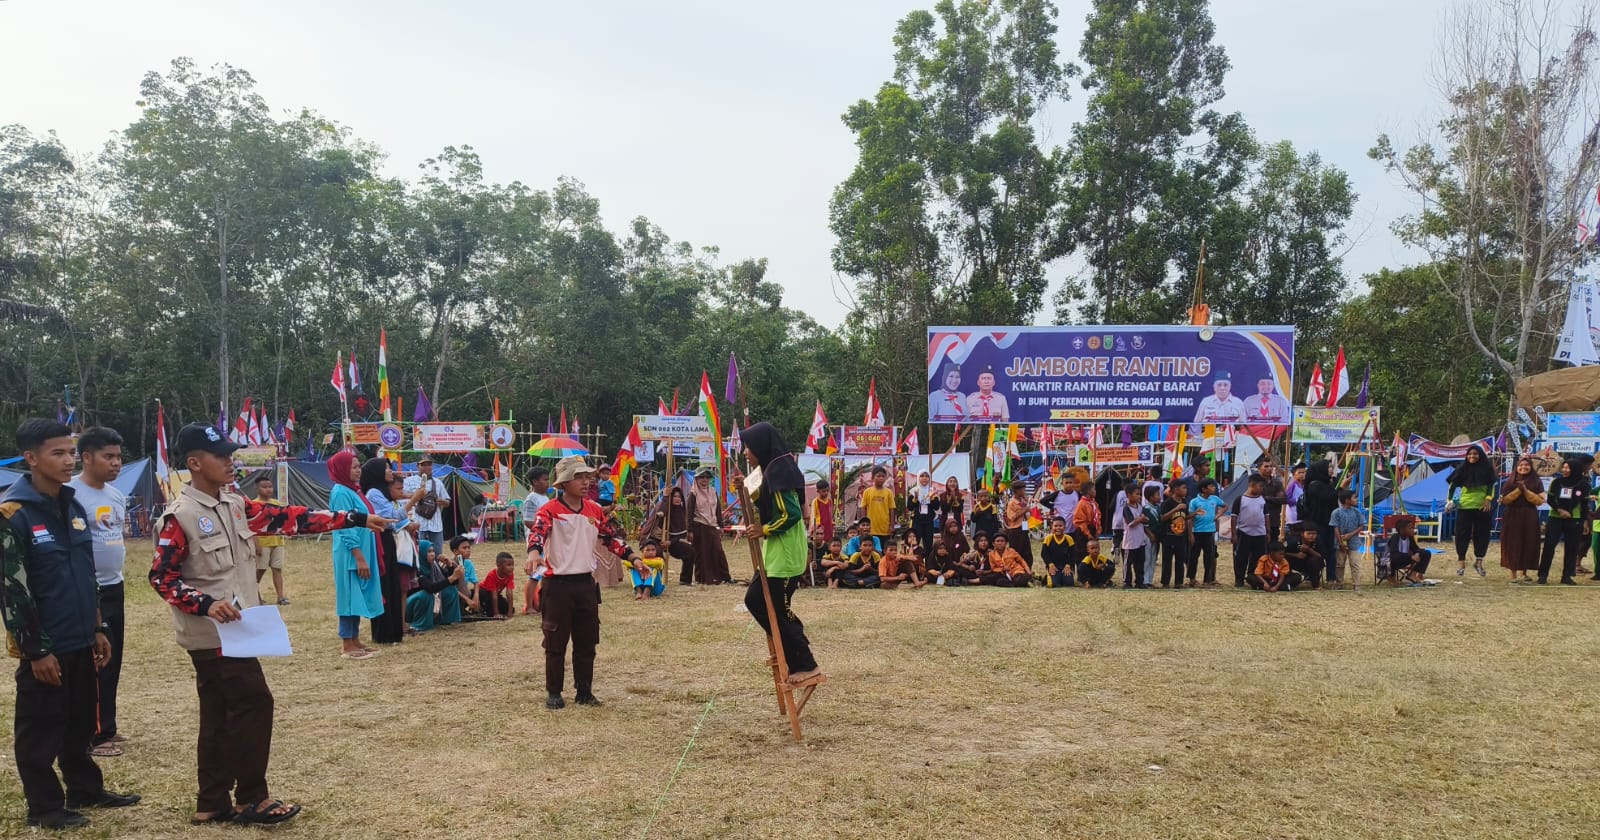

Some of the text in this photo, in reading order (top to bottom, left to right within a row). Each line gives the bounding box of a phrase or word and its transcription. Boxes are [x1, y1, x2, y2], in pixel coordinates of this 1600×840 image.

[1005, 356, 1210, 377] JAMBORE RANTING
[1012, 381, 1201, 391] KWARTIR RANTING RENGAT BARAT
[1018, 397, 1194, 406] DI BUMI PERKEMAHAN DESA SUNGAI BAUNG
